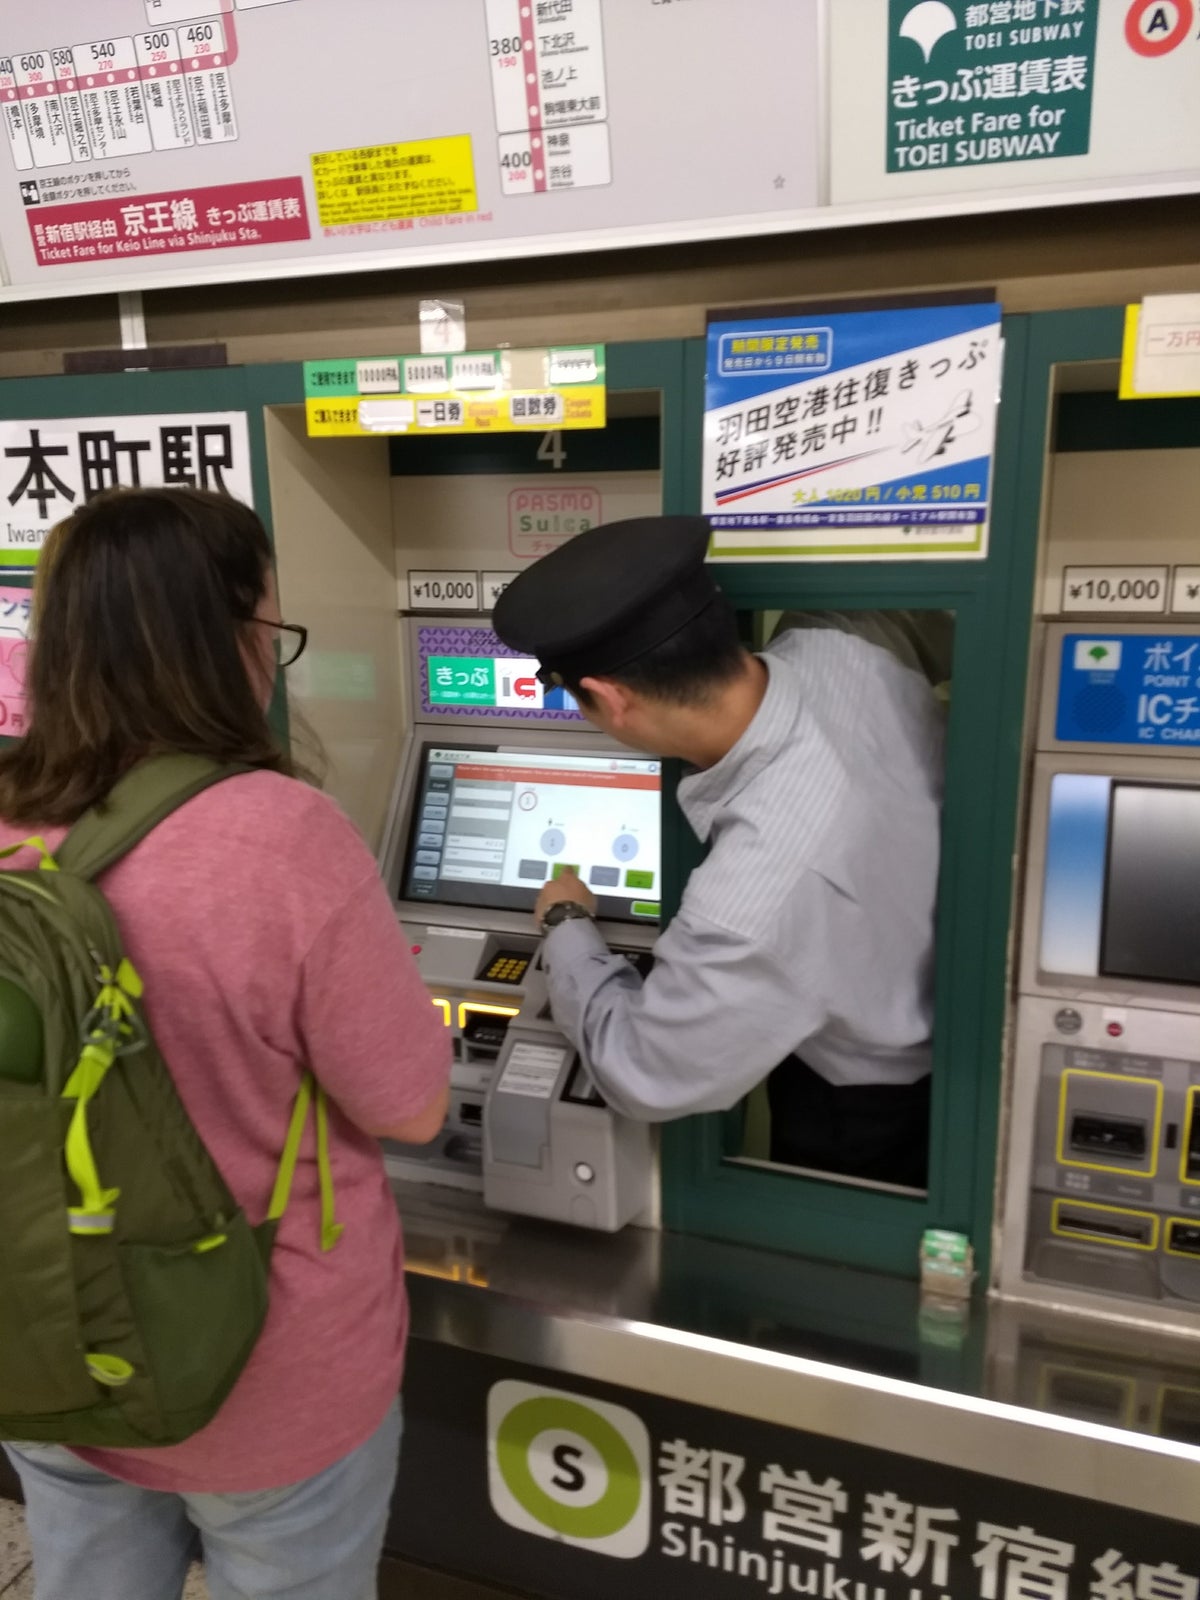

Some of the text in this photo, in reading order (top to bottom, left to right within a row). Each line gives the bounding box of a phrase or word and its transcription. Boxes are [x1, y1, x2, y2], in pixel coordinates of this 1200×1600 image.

[965, 0, 1085, 28] 都営地下鉄
[1146, 6, 1169, 34] A
[144, 33, 169, 51] 500
[187, 25, 212, 42] 460
[538, 31, 576, 51] 下北沢
[964, 20, 1084, 51] TOEI SUBWAY
[91, 42, 115, 60] 540
[490, 36, 522, 56] 380
[21, 54, 44, 71] 600
[53, 49, 73, 66] 580
[891, 54, 1088, 109] きっぷ運賃表
[895, 104, 1066, 141] Ticket Fare for
[500, 151, 532, 168] 400
[895, 132, 1060, 168] TOEI SUBWAY
[45, 218, 118, 244] 新宿駅経由
[120, 198, 198, 236] 京王線
[206, 198, 301, 226] きっぷ運賃表
[40, 227, 261, 260] Ticket Fare for Keio Line via Shinjuku Sta.
[717, 339, 988, 446] 羽田空港往復きっぷ
[419, 402, 461, 421] 一日券
[512, 396, 556, 417] 回数券
[536, 431, 567, 469] 4
[516, 493, 593, 512] PASMO
[519, 514, 591, 532] Suica
[413, 582, 474, 601] ¥10,000
[1069, 579, 1160, 602] ¥10,000
[1143, 675, 1190, 687] POINT
[551, 1444, 586, 1492] S
